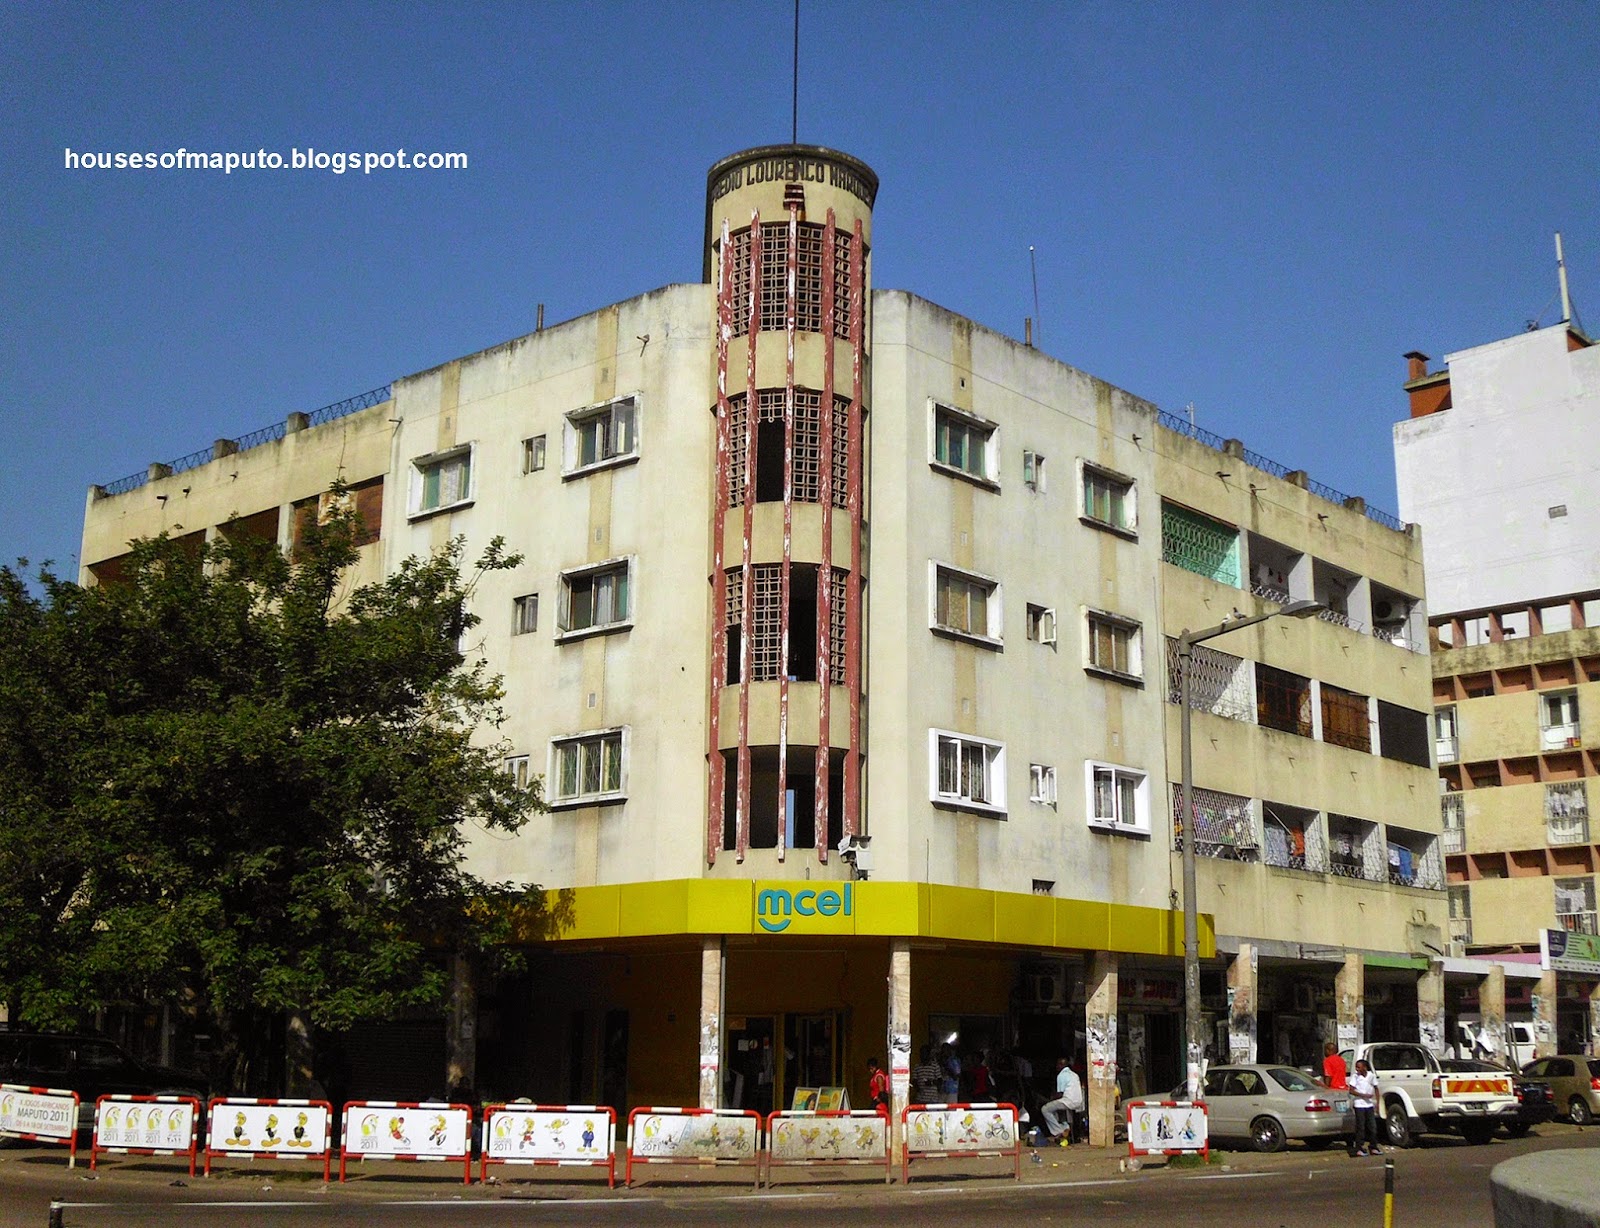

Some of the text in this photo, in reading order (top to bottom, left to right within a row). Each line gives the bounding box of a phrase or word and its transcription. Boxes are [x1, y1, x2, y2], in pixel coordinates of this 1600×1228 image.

[712, 168, 742, 202] REDIO
[747, 158, 825, 187] LOURENCO
[758, 883, 852, 917] mcel
[17, 1107, 69, 1122] MAPUTO 2011
[103, 1133, 118, 1142] 2011
[124, 1134, 139, 1142] 2011
[146, 1135, 161, 1144] 2011
[360, 1141, 378, 1149] 2011
[494, 1143, 512, 1151] 2011
[915, 1138, 931, 1147] 2011
